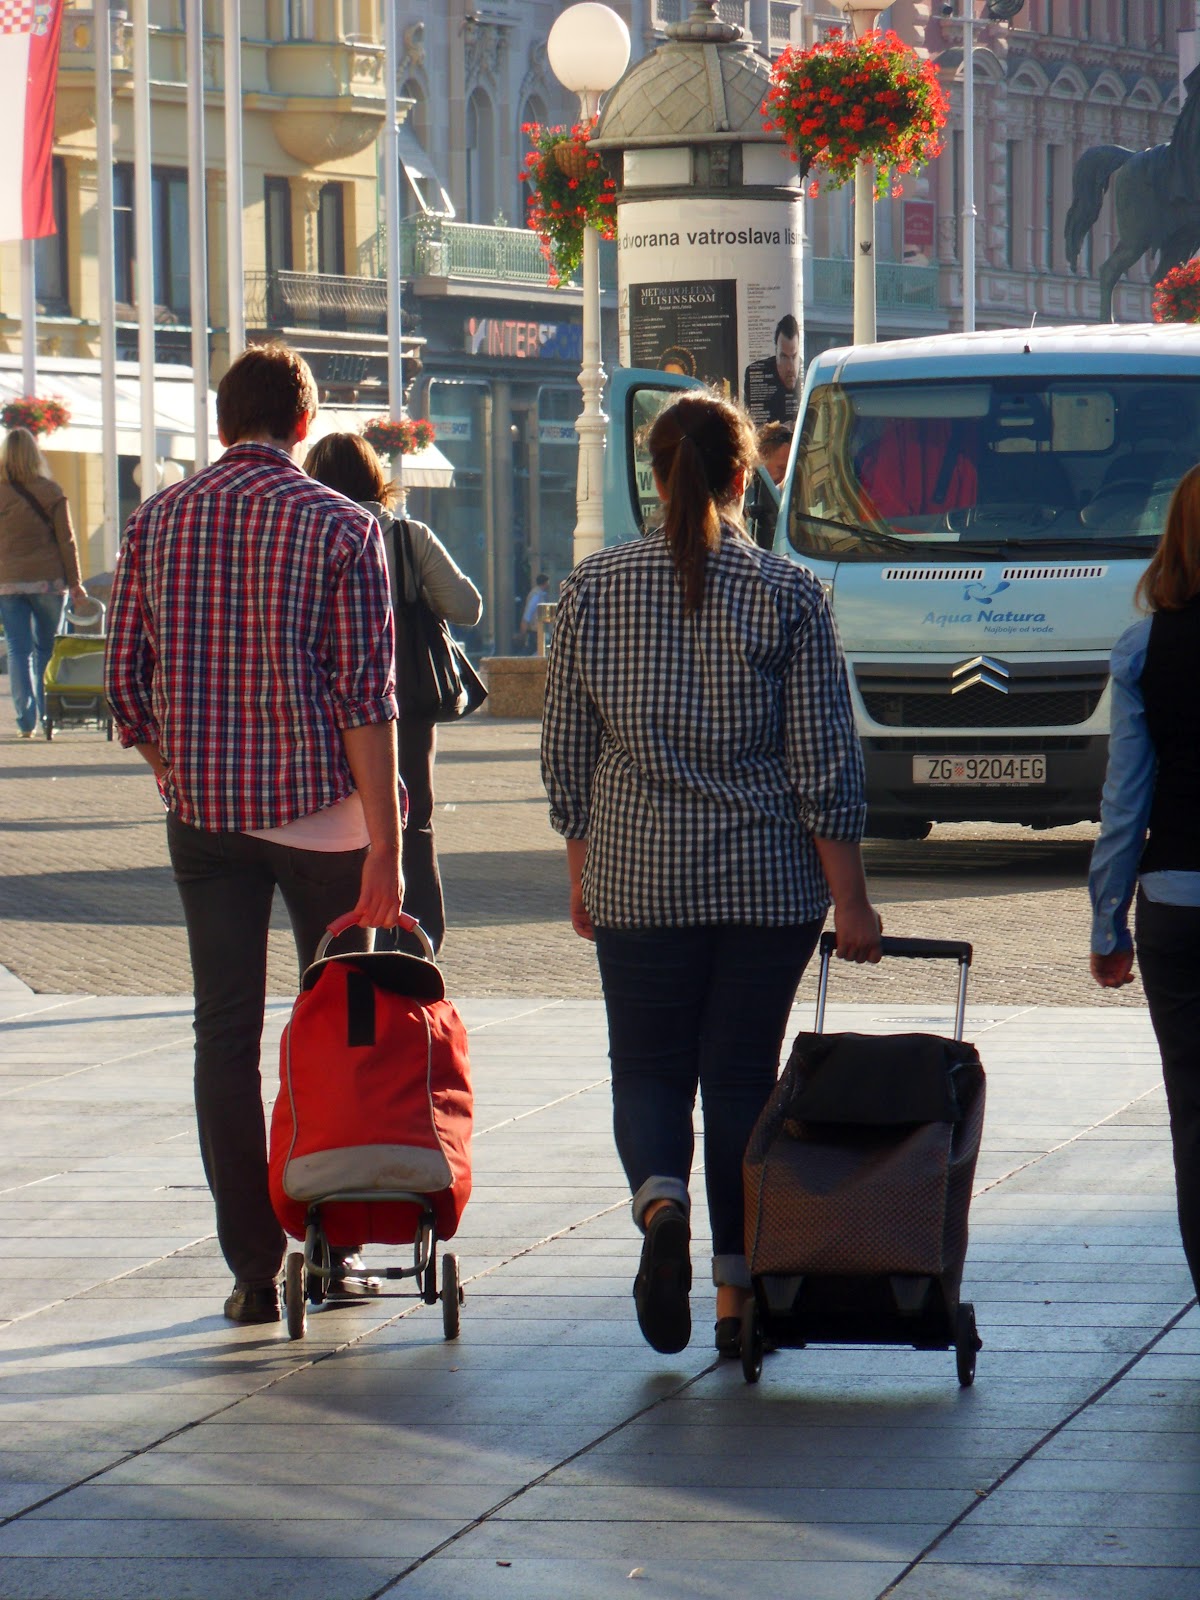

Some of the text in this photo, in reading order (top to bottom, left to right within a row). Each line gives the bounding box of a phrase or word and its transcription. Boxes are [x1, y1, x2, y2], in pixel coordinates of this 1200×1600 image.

[622, 232, 680, 250] dvorana
[687, 227, 781, 245] vatroslava
[641, 296, 648, 306] U
[650, 293, 716, 305] LISINSKOM
[921, 609, 1046, 628] Aqua Natura
[983, 624, 1054, 635] Najbolje od vode
[928, 759, 953, 780] ZG
